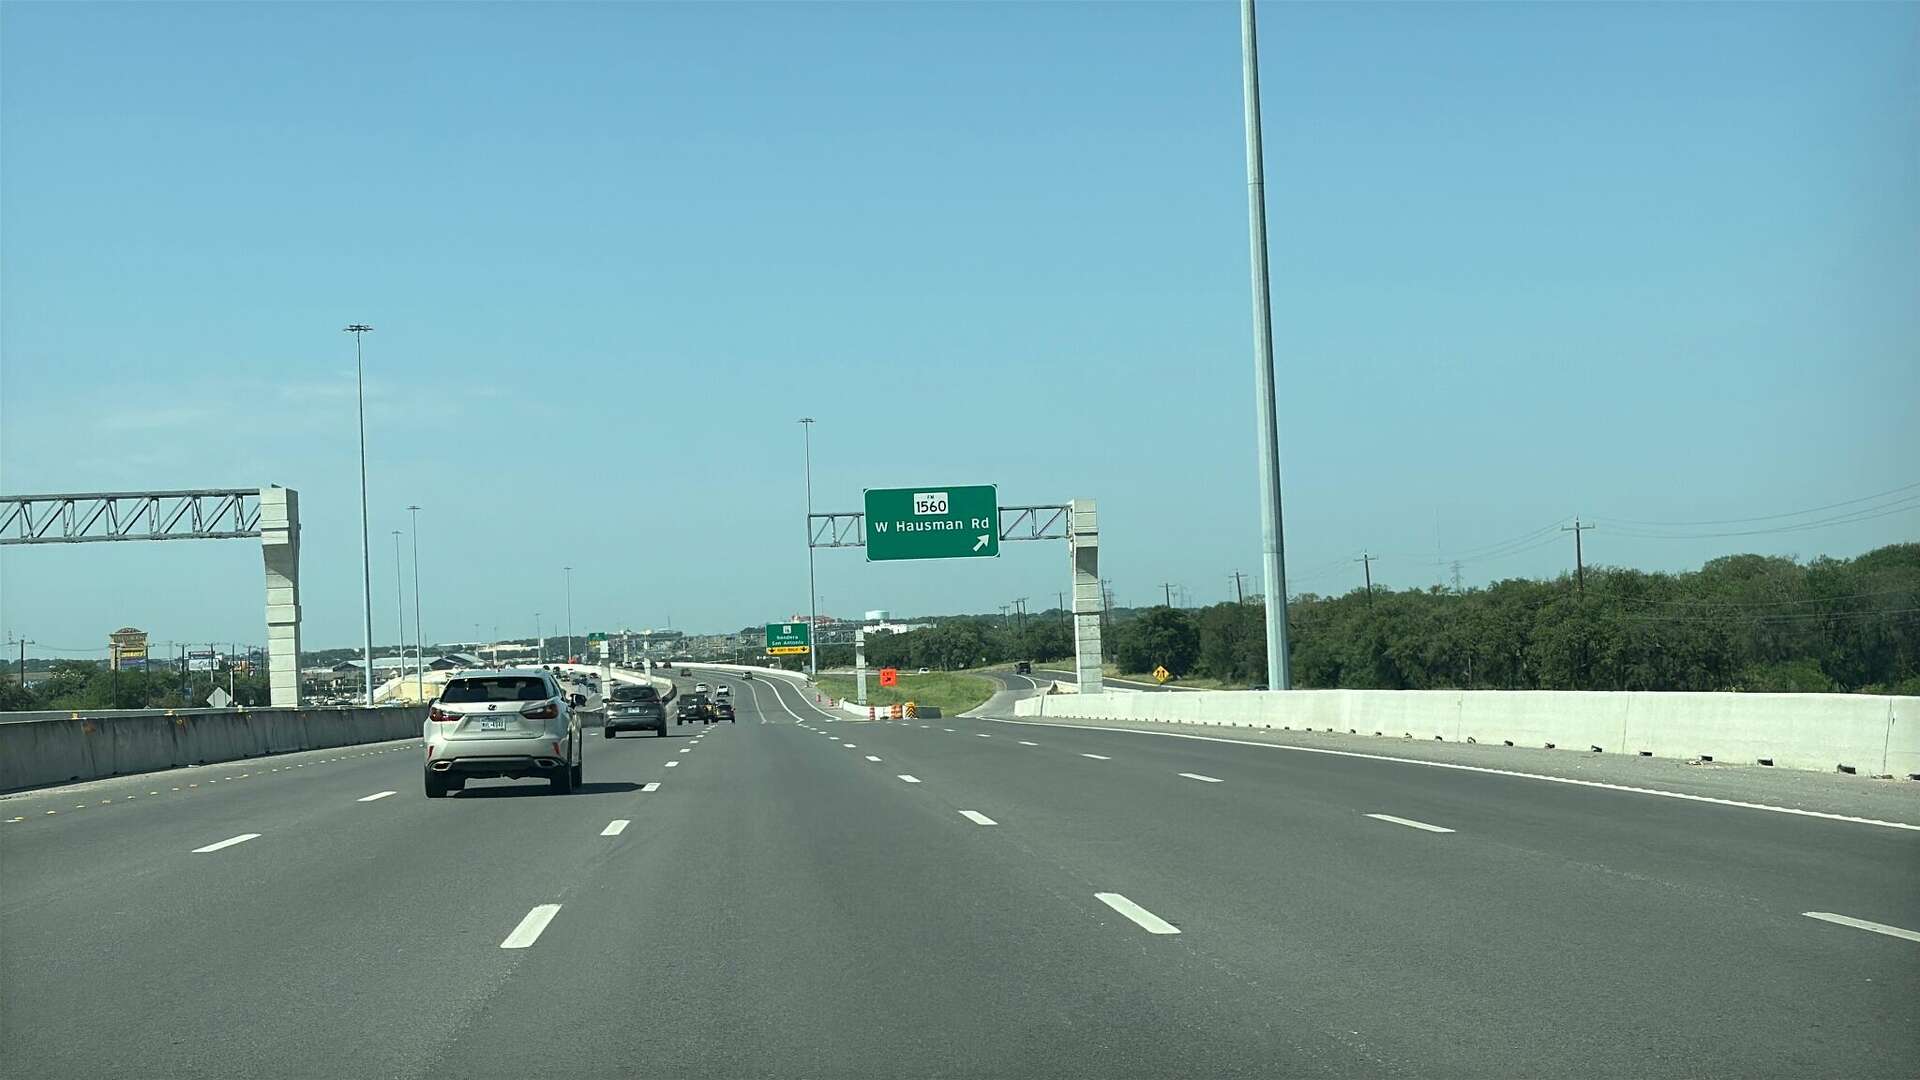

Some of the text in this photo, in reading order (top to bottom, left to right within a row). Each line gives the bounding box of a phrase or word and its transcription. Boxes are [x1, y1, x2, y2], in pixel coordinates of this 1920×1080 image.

[916, 500, 947, 513] 1560
[875, 517, 989, 533] W Hausman Rd
